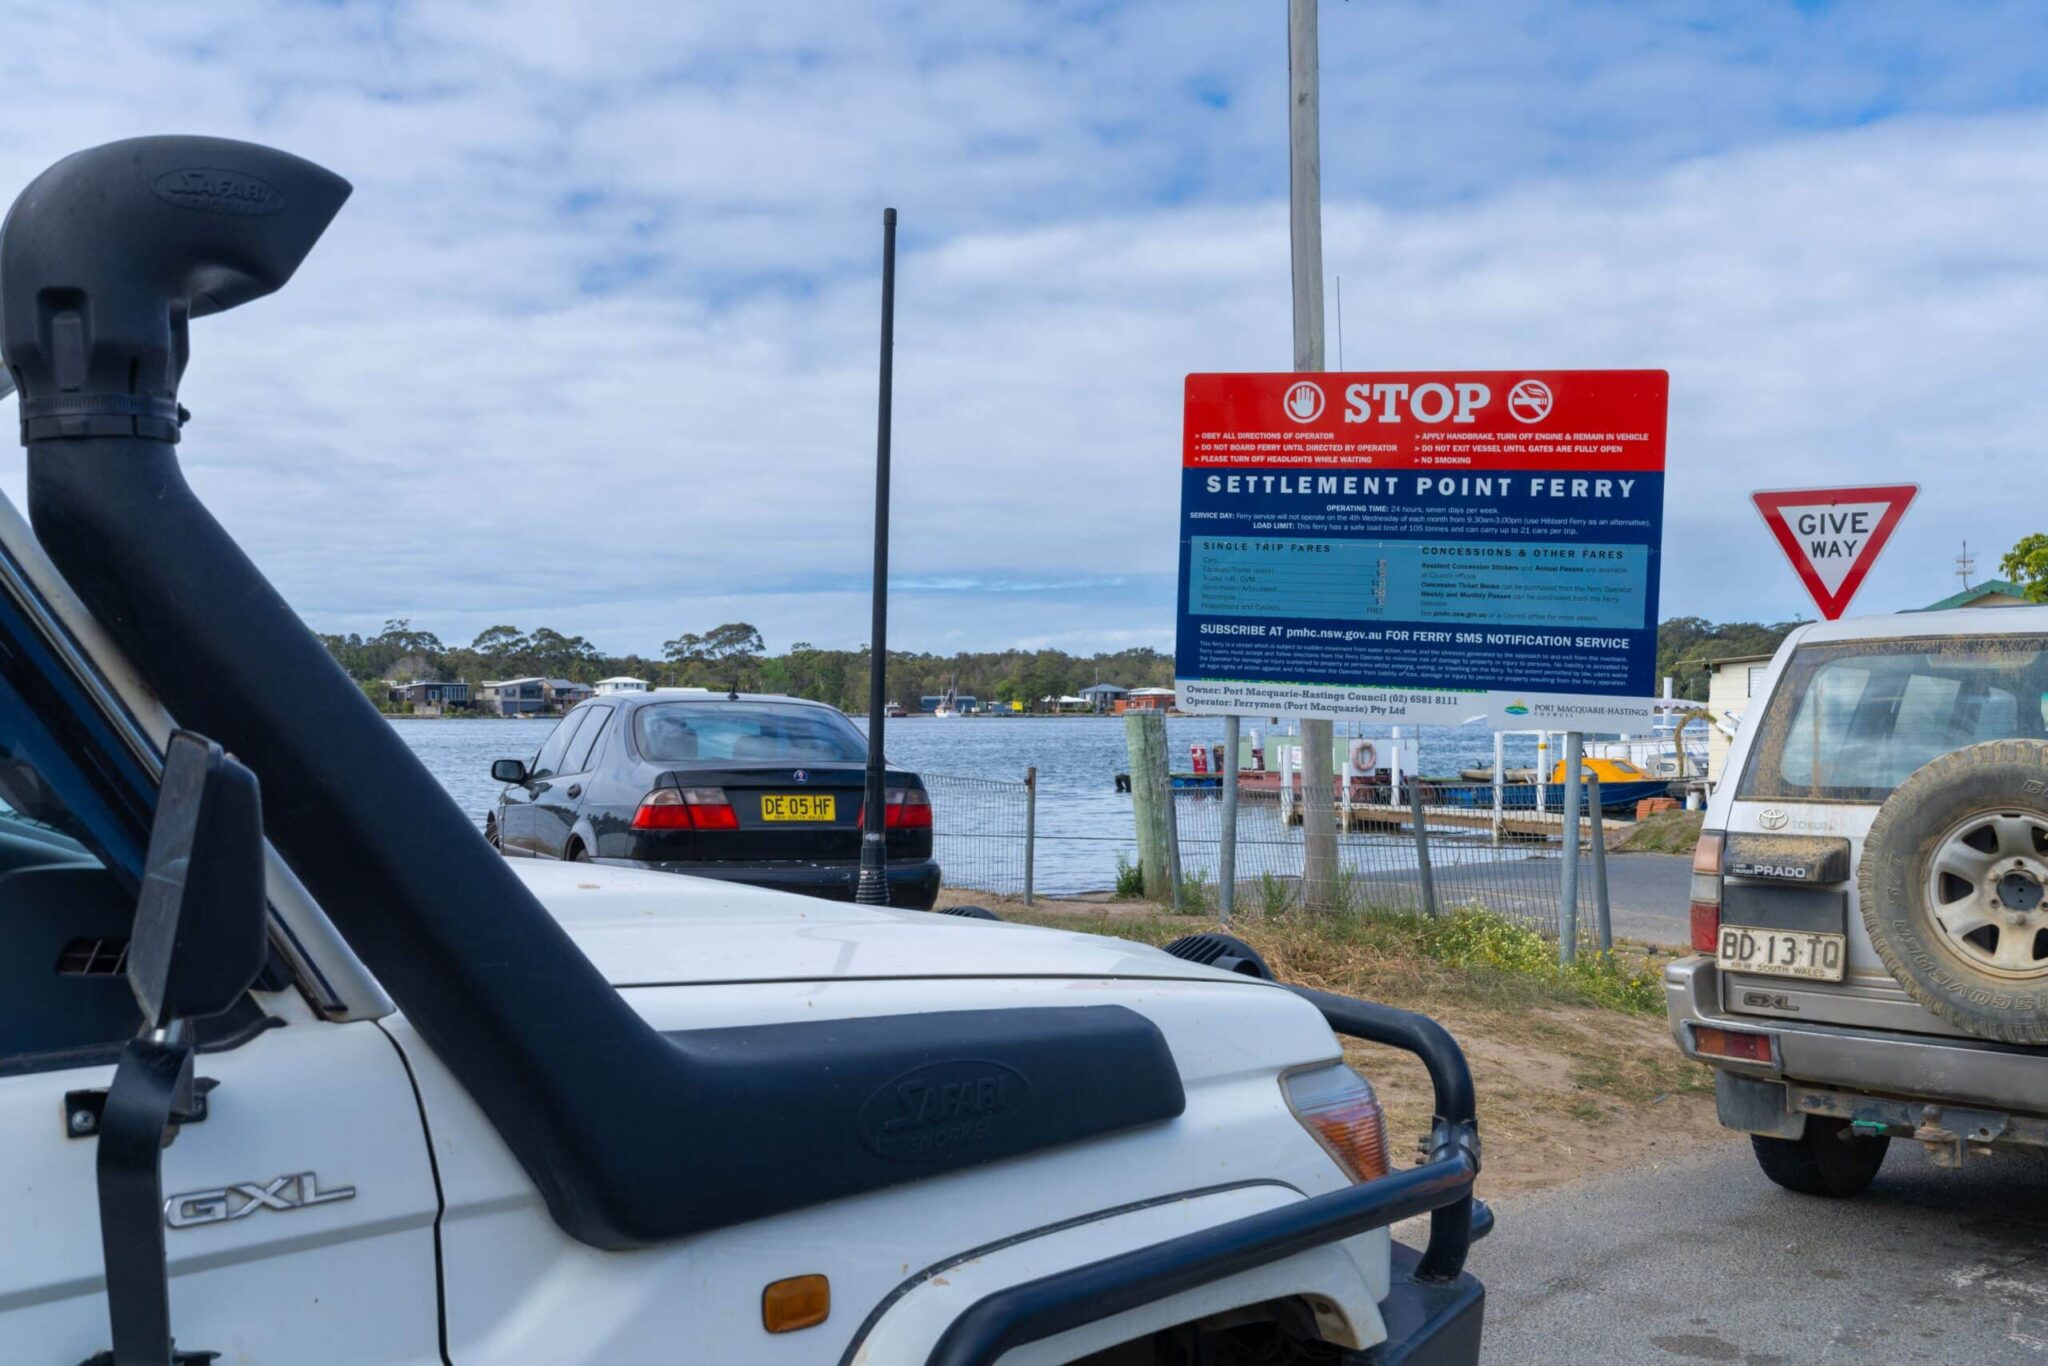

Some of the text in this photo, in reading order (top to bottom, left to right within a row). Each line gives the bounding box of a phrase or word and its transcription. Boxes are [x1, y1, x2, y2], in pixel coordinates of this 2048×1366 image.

[167, 172, 267, 204] SAFARI
[1344, 383, 1491, 423] STOP
[1206, 475, 1635, 497] SETTLEMENT POINT FERRY
[1236, 512, 1252, 522] Ferry
[1300, 513, 1326, 522] operate
[1362, 514, 1399, 524] Wednesday
[1569, 517, 1586, 526] Ferry
[1402, 506, 1424, 515] hours,
[1448, 506, 1464, 516] days
[1312, 523, 1328, 532] ferry
[1798, 512, 1868, 535] GIVE
[1203, 543, 1331, 553] SINGLE TRIP FARES
[1422, 547, 1624, 560] CONCESSIONS & OTHER FARES
[1812, 540, 1858, 558] WAY
[1200, 624, 1630, 649] SUBSCRIBE AT pmhc.nsw.gov.au FOR FERRY SMS NOTIFICATION SERVICE
[1187, 685, 1458, 704] Owner: Port Macquarie-Hastings Council (02) 6581 8111
[1186, 697, 1406, 714] Operator: Ferrymen (Port Macquarie) Pty Ltd
[1557, 705, 1648, 716] MACQUARIE-HASTINGS
[1792, 821, 1835, 830] TOYOTA
[1754, 865, 1806, 878] PRADO
[1732, 962, 1826, 978] NEW SOUTH WALES
[1744, 992, 1799, 1012] GXL
[884, 1074, 1008, 1131] SAFARI
[164, 1172, 356, 1229] GXL
